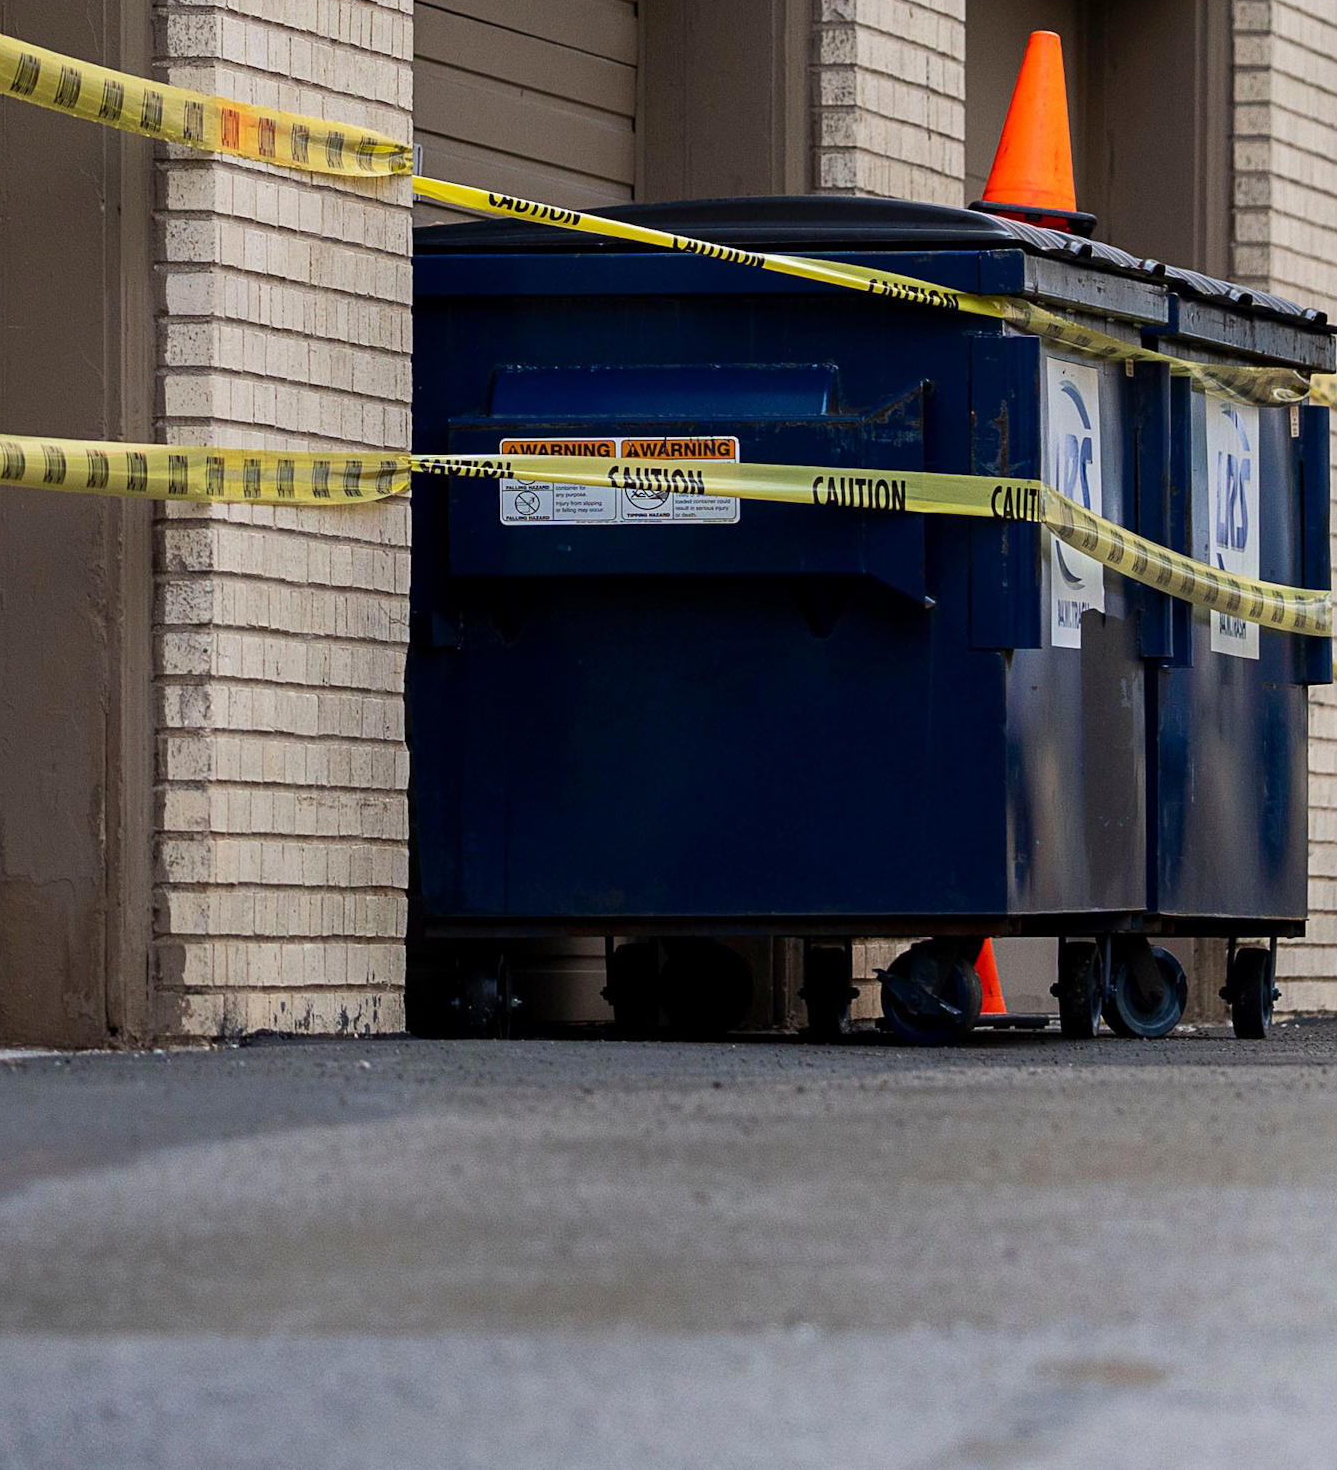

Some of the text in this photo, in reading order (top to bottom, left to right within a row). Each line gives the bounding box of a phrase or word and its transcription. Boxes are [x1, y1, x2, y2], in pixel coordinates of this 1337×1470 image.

[488, 193, 581, 226] CAUTION
[520, 443, 611, 457] WARNING
[640, 442, 731, 457] WARNING
[419, 458, 515, 479] CAUTION
[608, 465, 705, 495] CAUTION
[812, 475, 907, 512] CAUTION
[1215, 450, 1251, 553] LRS
